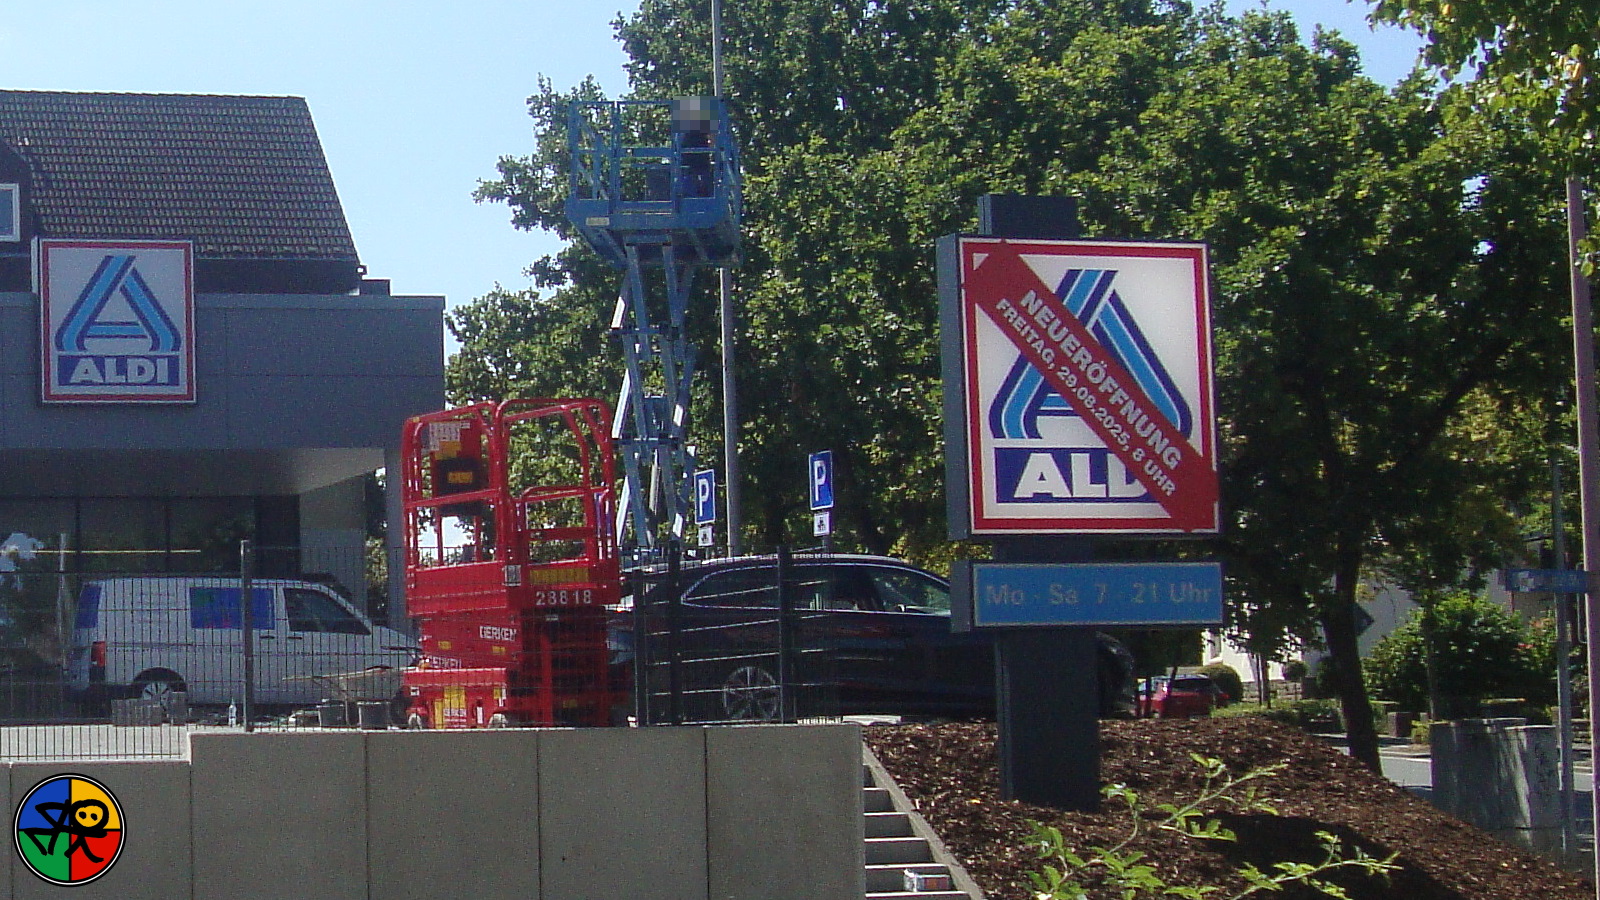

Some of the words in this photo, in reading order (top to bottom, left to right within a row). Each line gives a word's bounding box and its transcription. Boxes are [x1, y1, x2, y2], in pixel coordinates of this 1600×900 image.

[69, 357, 169, 383] ALDI
[1020, 289, 1181, 470] NEUERÖFFNUNG
[995, 298, 1055, 370] FREITAG,
[1056, 366, 1130, 452] 29.08.2025,
[1132, 448, 1146, 461] 8
[1143, 459, 1176, 497] UHR
[814, 460, 826, 502] P
[1013, 452, 1148, 498] ALD
[698, 478, 709, 517] P
[985, 584, 1024, 605] Mo
[1049, 584, 1079, 605] Sa
[1168, 582, 1213, 603] Uhr
